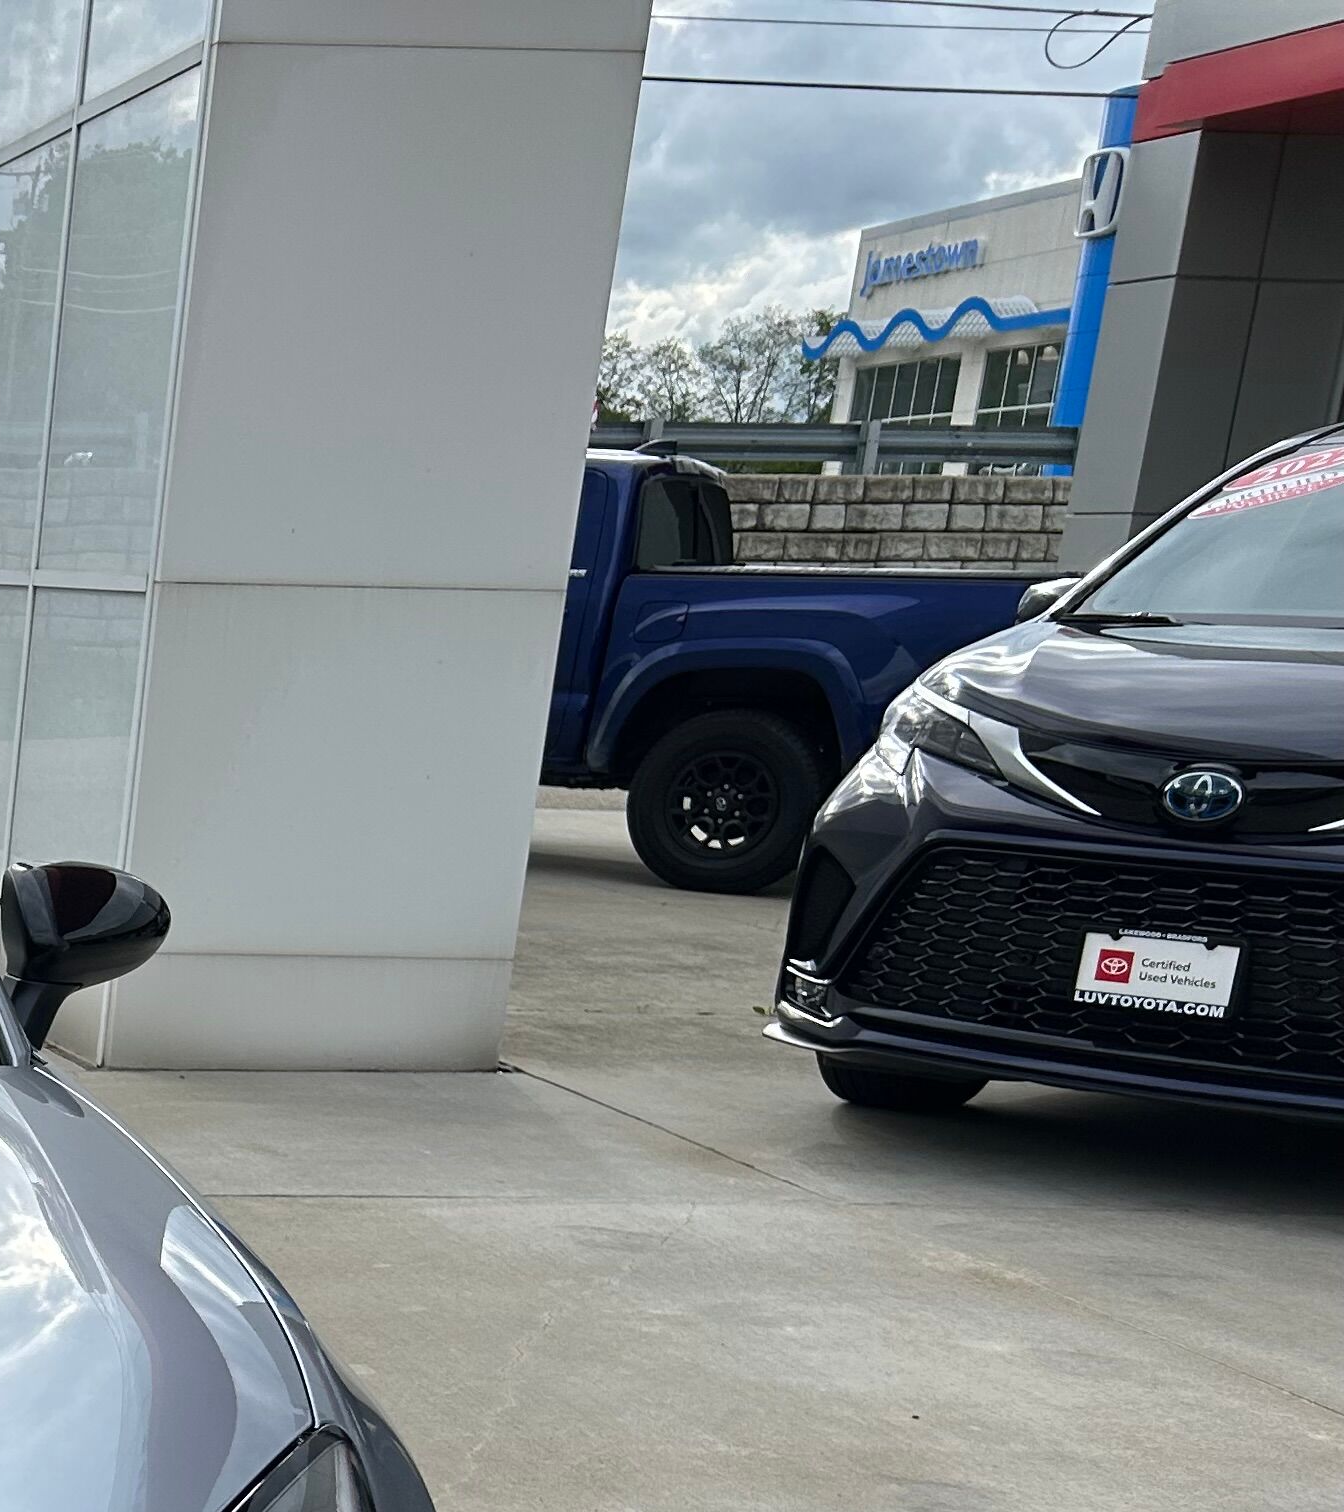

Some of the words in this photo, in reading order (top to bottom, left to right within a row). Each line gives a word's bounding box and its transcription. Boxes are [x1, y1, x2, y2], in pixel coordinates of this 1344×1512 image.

[859, 239, 979, 297] Jamestown
[1141, 957, 1192, 972] Certified
[1138, 971, 1168, 984] Used
[1170, 974, 1217, 989] Vehicles
[1073, 989, 1225, 1018] LUVTOYOTA.COM
